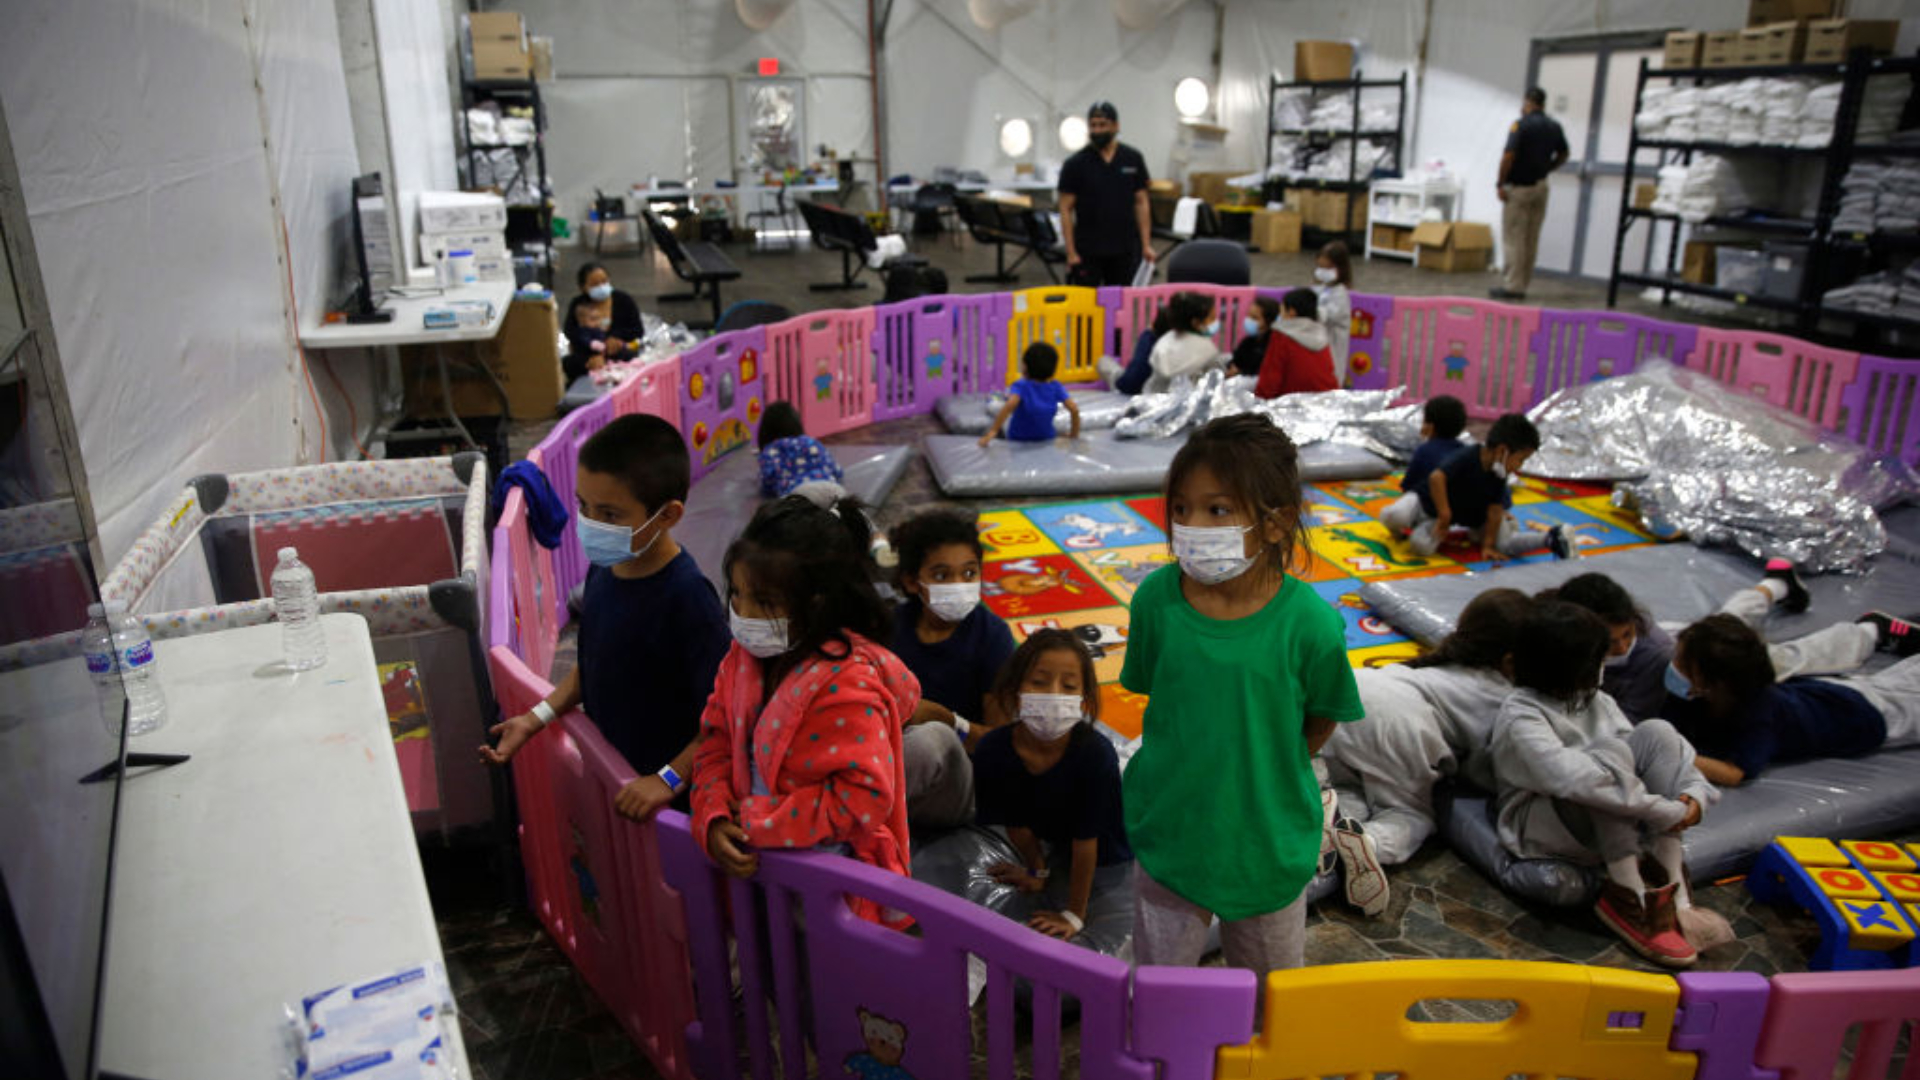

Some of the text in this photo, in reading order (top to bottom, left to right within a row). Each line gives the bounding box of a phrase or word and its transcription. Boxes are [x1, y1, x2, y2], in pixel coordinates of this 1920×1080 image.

[986, 530, 1039, 546] B
[1065, 534, 1103, 547] U
[1002, 558, 1041, 573] Y
[1089, 552, 1132, 567] V
